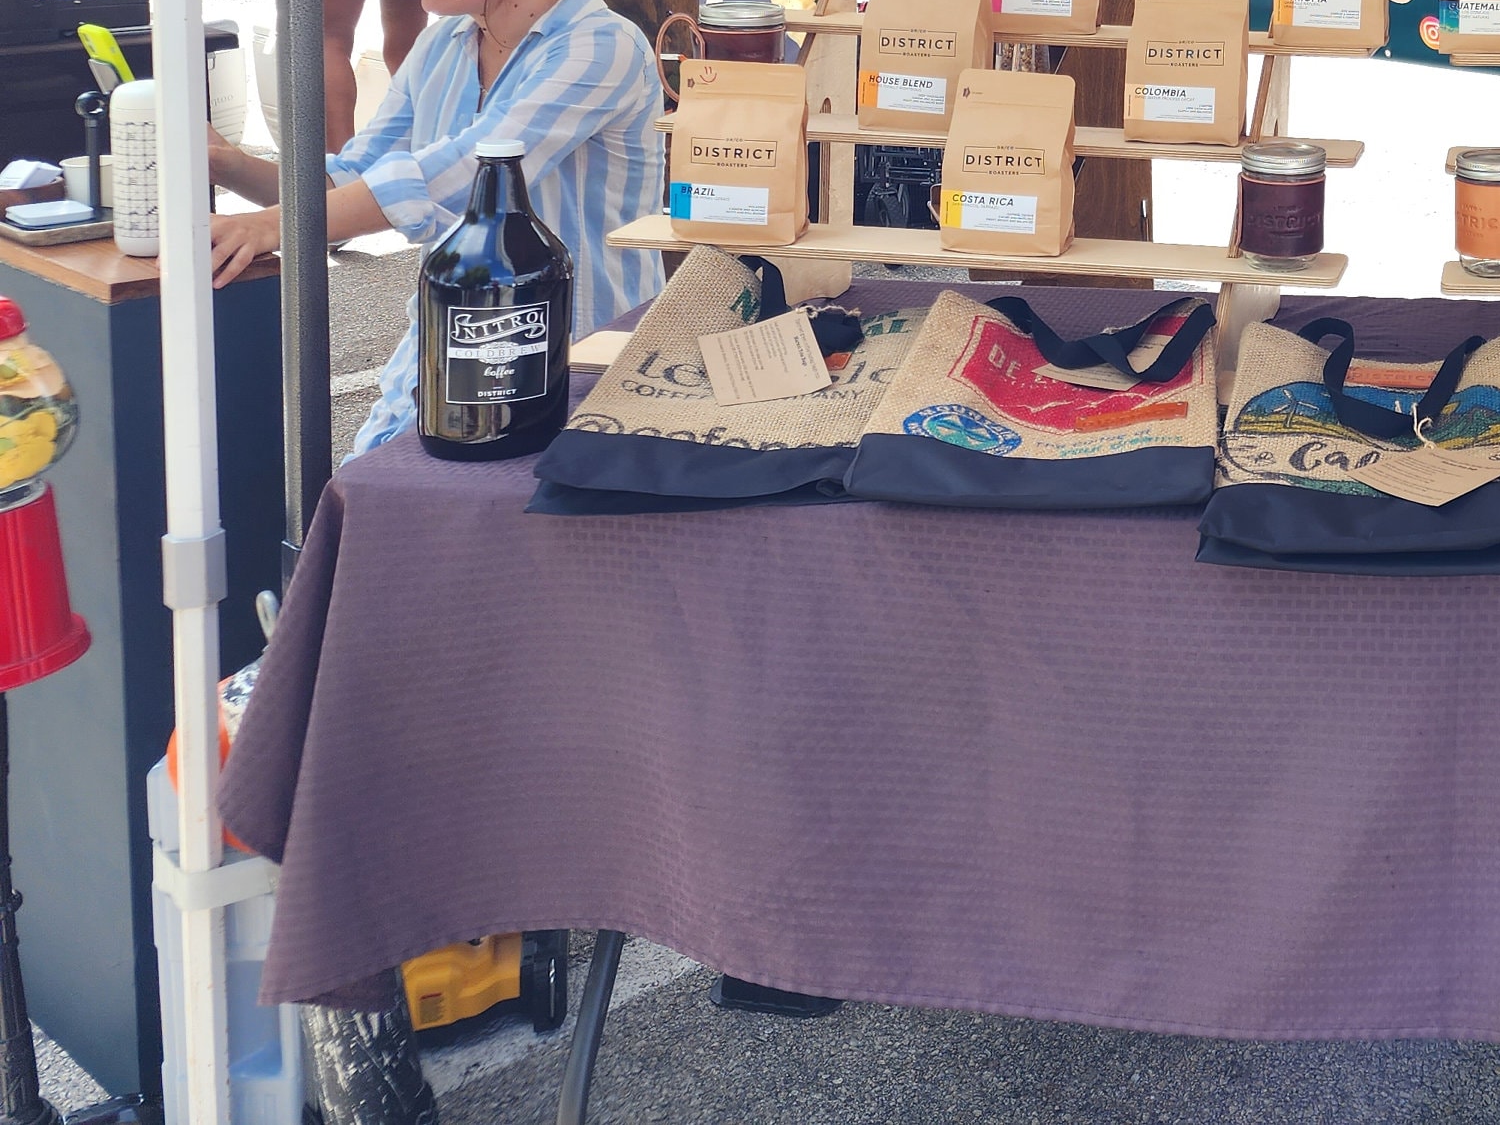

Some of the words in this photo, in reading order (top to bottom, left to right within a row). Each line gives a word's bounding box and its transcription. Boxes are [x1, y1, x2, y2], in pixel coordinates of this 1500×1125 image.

[881, 36, 954, 50] DISTRICT
[1148, 48, 1222, 59] DISTRICT
[869, 75, 900, 85] HOUSE
[902, 78, 933, 89] BLEND
[1134, 87, 1187, 97] COLOMBIA
[693, 146, 774, 160] DISTRICT
[965, 154, 1042, 167] DISTRICT
[680, 186, 716, 196] BRAZIL
[952, 194, 985, 205] COSTA
[988, 197, 1014, 206] RICA
[463, 311, 539, 339] NITRO
[477, 388, 517, 398] DISTRICT
